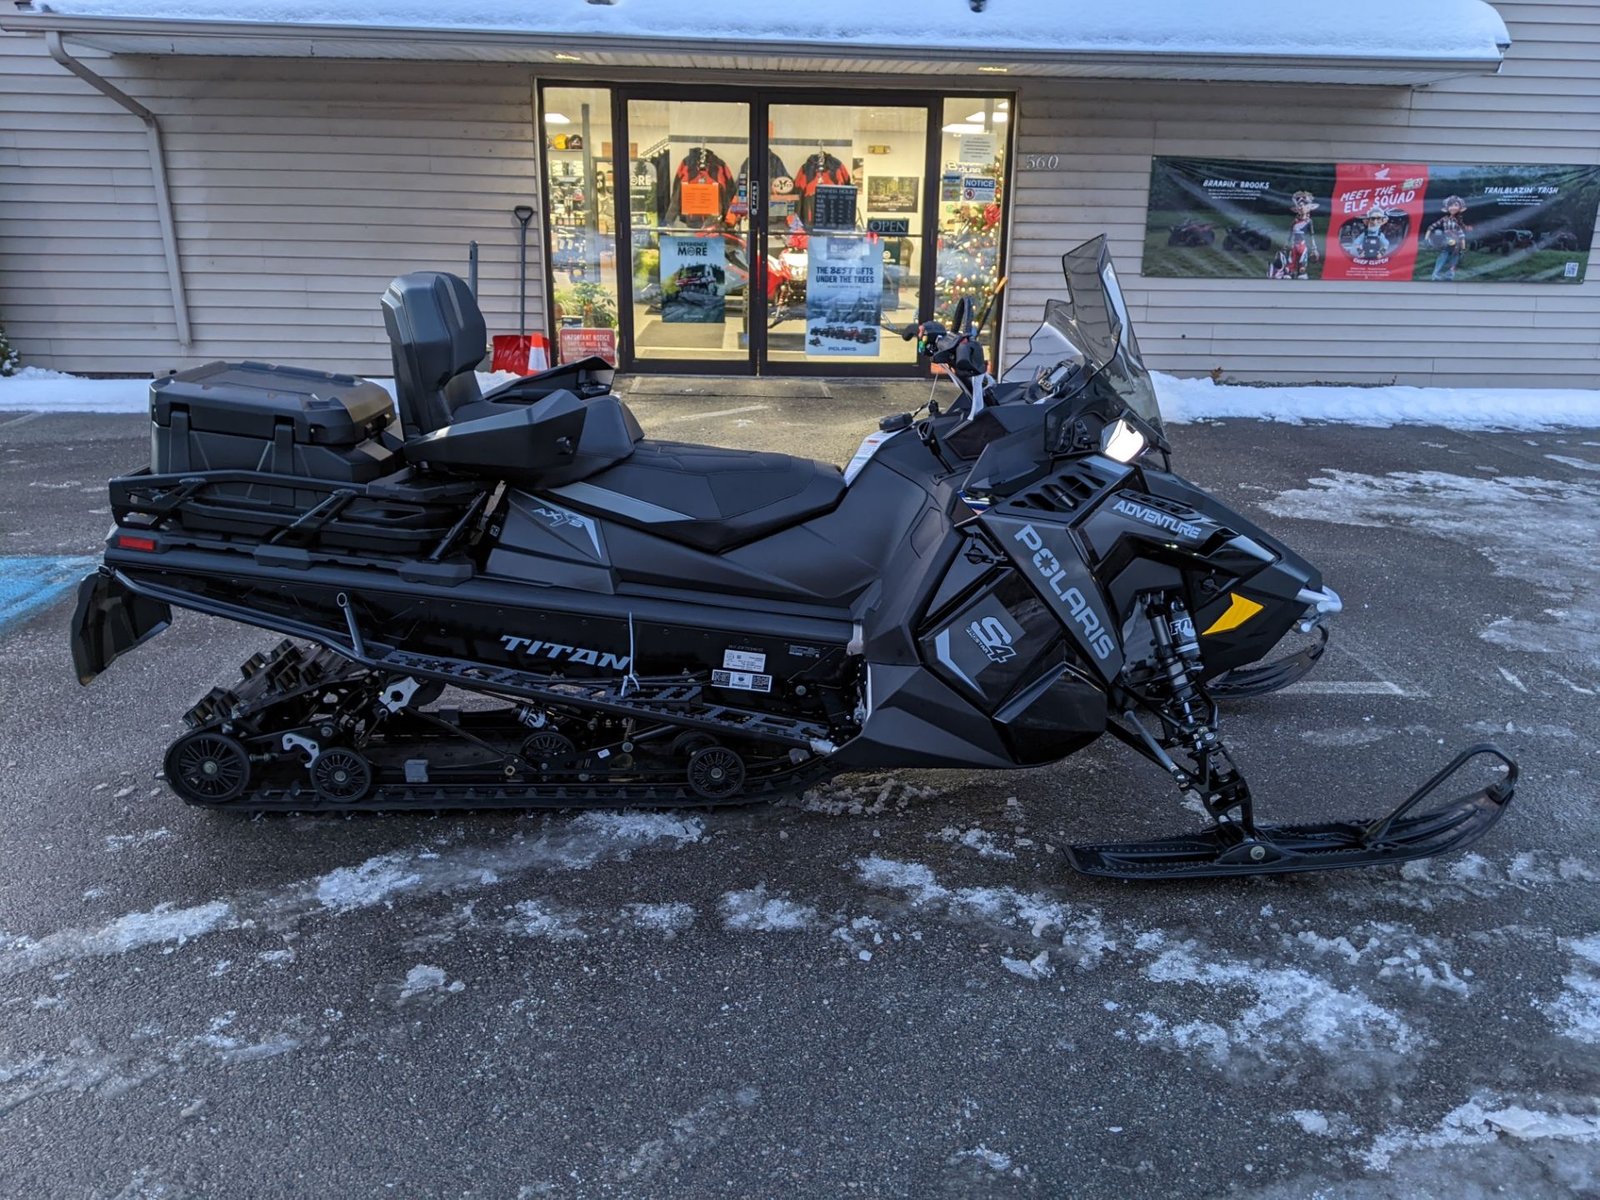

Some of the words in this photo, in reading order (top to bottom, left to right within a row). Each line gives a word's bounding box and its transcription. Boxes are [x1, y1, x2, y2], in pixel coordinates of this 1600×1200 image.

[965, 180, 994, 188] NOTICE
[1240, 181, 1270, 190] BROOKS
[1340, 189, 1371, 201] MEET
[1374, 185, 1396, 196] THE
[1344, 199, 1369, 213] ELF
[1372, 190, 1416, 208] SQUAD
[870, 221, 907, 232] OPEN
[677, 246, 708, 256] MORE
[816, 266, 829, 275] THE
[830, 266, 855, 275] BEST
[816, 275, 838, 283] UNDER
[854, 276, 875, 284] TREES
[1112, 499, 1202, 539] ADVENTURE
[1014, 523, 1115, 661] POLARIS
[500, 634, 632, 671] TITAN
